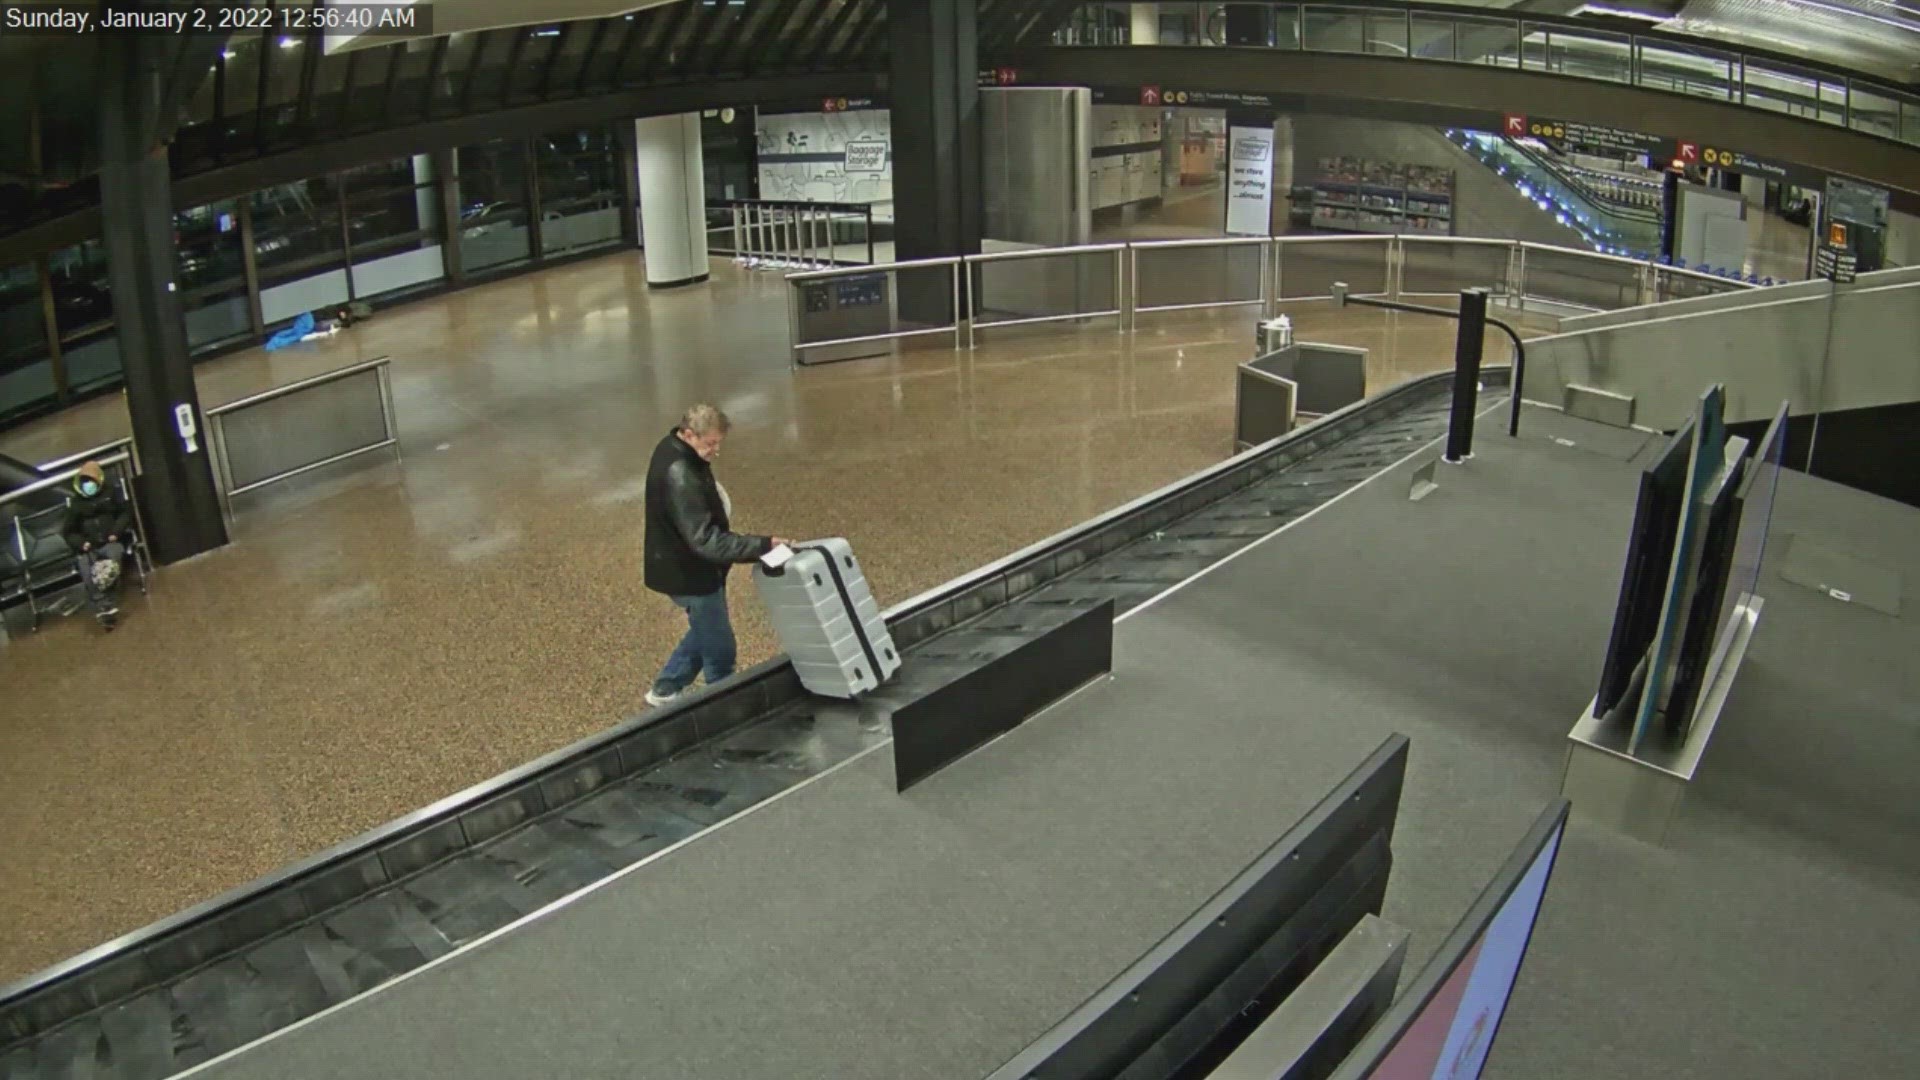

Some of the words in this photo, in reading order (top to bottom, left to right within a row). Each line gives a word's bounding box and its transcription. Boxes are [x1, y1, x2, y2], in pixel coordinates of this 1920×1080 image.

[848, 145, 883, 157] Baggage
[847, 155, 879, 167] Storage
[1233, 179, 1266, 190] anything
